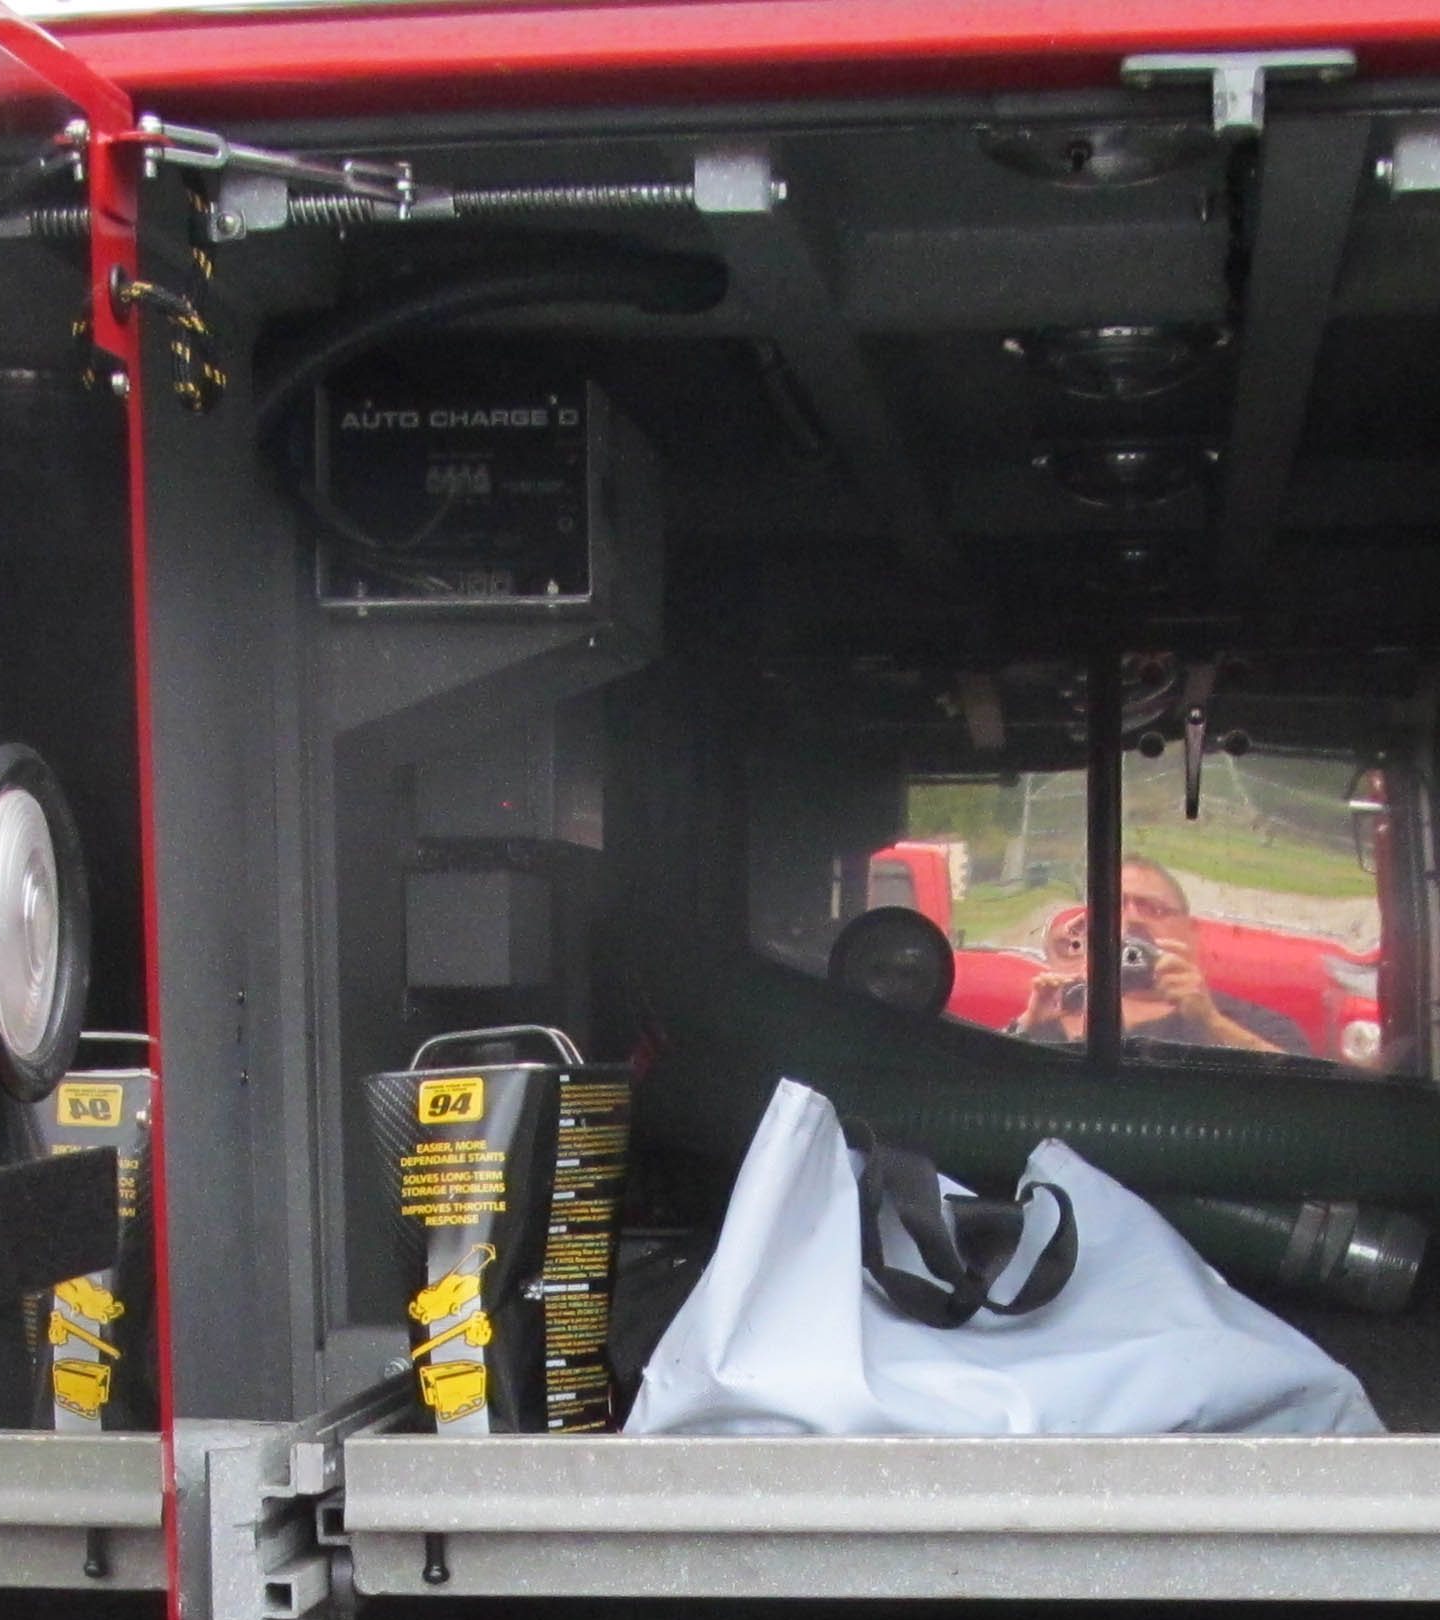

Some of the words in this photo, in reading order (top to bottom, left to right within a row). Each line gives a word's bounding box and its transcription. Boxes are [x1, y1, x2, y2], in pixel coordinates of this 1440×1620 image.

[341, 410, 420, 430] AUTO
[429, 409, 548, 428] CHARGE
[428, 1093, 472, 1117] 94
[455, 1139, 487, 1151] MORE
[403, 1173, 439, 1185] SOLVES
[401, 1185, 447, 1198] STORAGE
